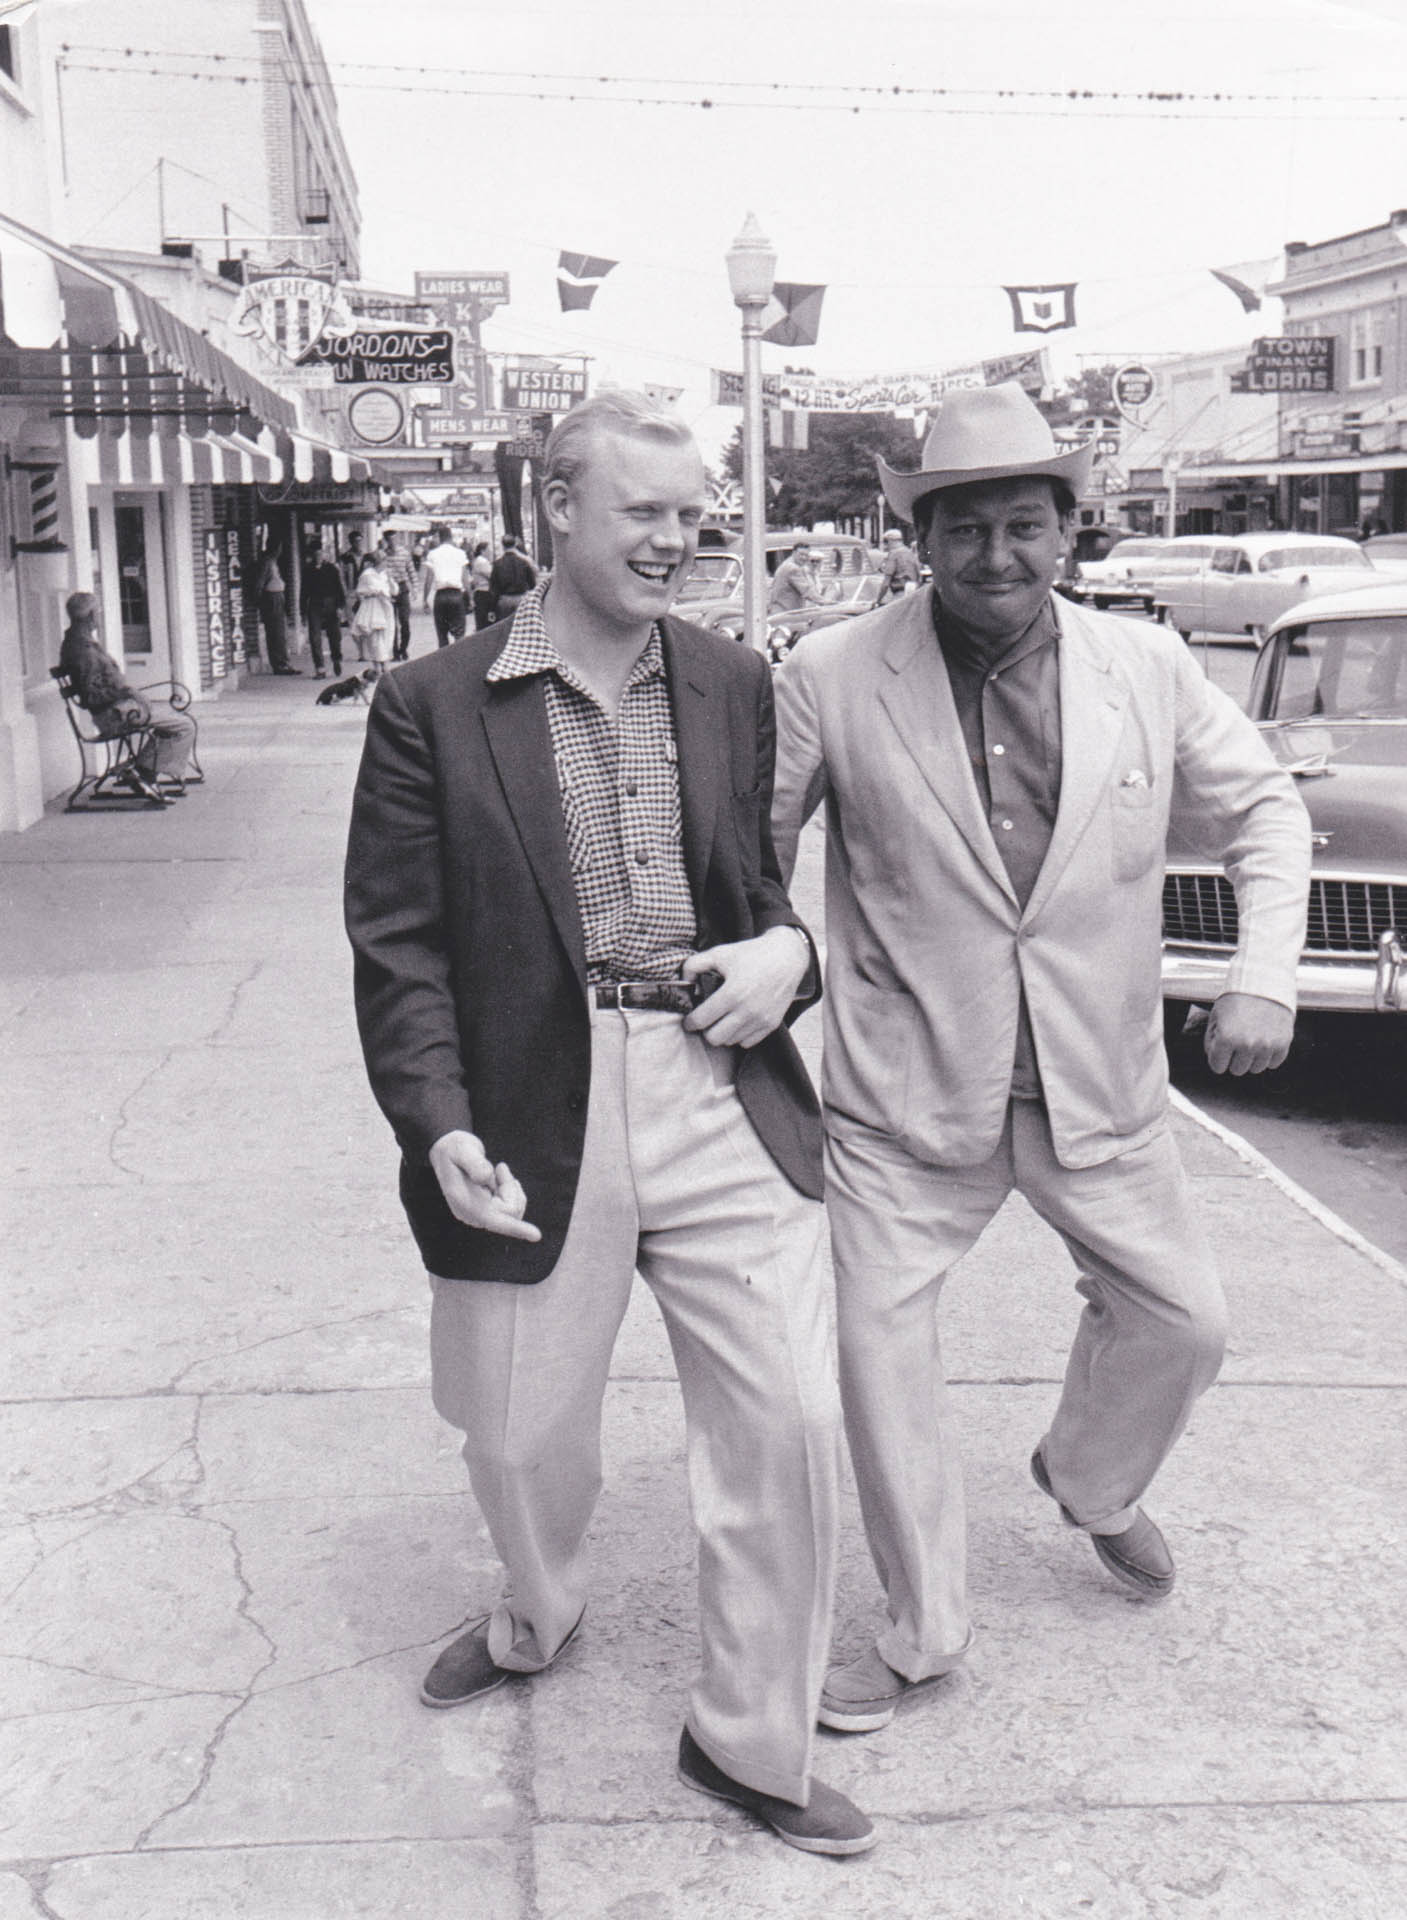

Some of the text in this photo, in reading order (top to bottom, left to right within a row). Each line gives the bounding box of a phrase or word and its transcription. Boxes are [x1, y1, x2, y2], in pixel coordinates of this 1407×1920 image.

[421, 280, 504, 294] LADIES WEAR
[1263, 339, 1328, 355] TOWN
[363, 360, 450, 381] WATCHES
[1254, 355, 1328, 368] FINANCE
[507, 372, 585, 392] WESTERN
[1248, 370, 1328, 390] LOANS
[518, 391, 571, 409] UNION
[794, 389, 810, 407] 12
[845, 385, 894, 412] Sports
[895, 382, 925, 406] Car
[471, 418, 508, 433] WEAR
[205, 533, 226, 678] INSURANCE
[226, 530, 246, 664] REAL ESTATE
